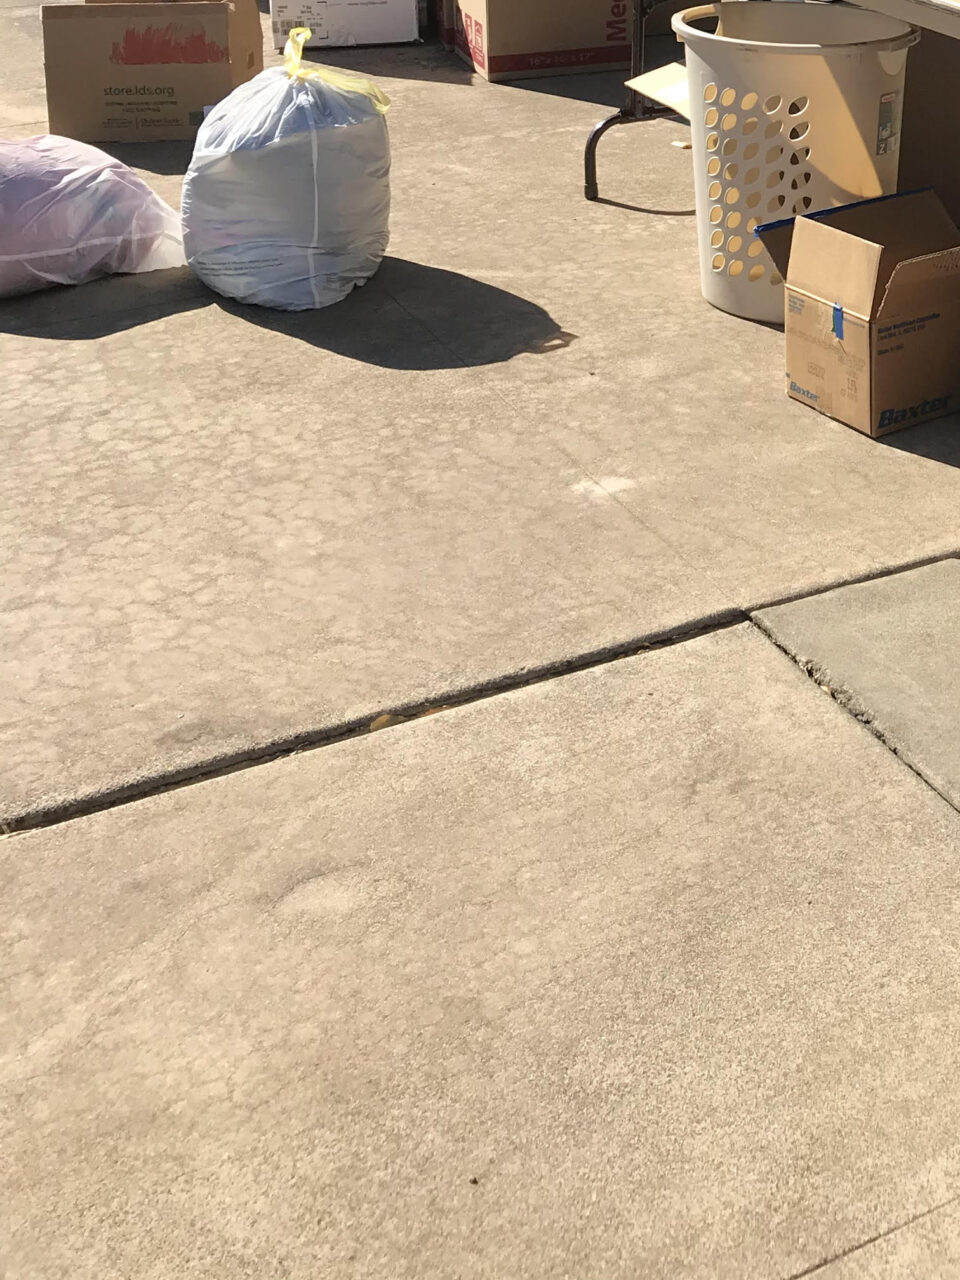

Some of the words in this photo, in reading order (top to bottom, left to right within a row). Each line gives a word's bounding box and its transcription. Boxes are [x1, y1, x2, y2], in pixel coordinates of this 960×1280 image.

[103, 85, 175, 97] store.lds.org
[789, 381, 820, 402] Baxter
[878, 394, 952, 429] Baxter
